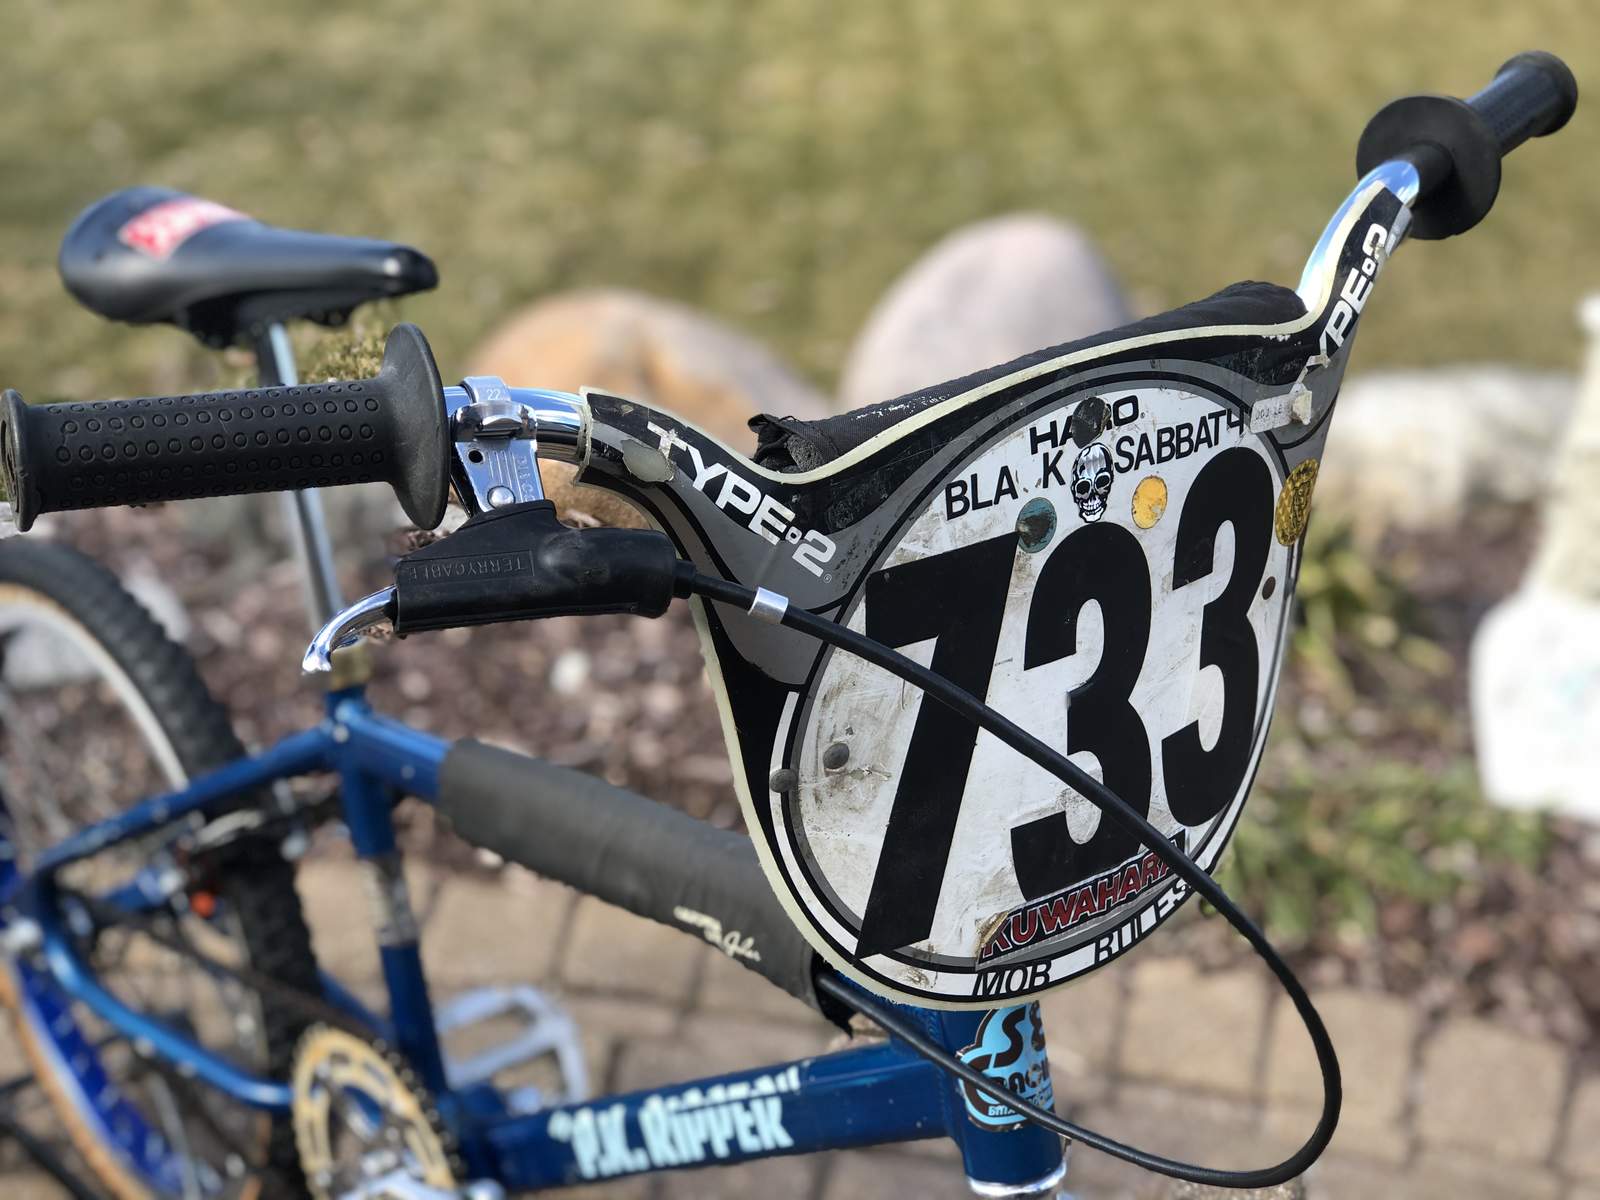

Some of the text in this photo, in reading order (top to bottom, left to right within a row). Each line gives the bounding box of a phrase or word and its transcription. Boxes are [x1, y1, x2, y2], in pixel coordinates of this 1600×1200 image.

[946, 449, 1064, 521] BLAK
[408, 556, 526, 582] TERRYCABLE
[855, 447, 1275, 958] 733
